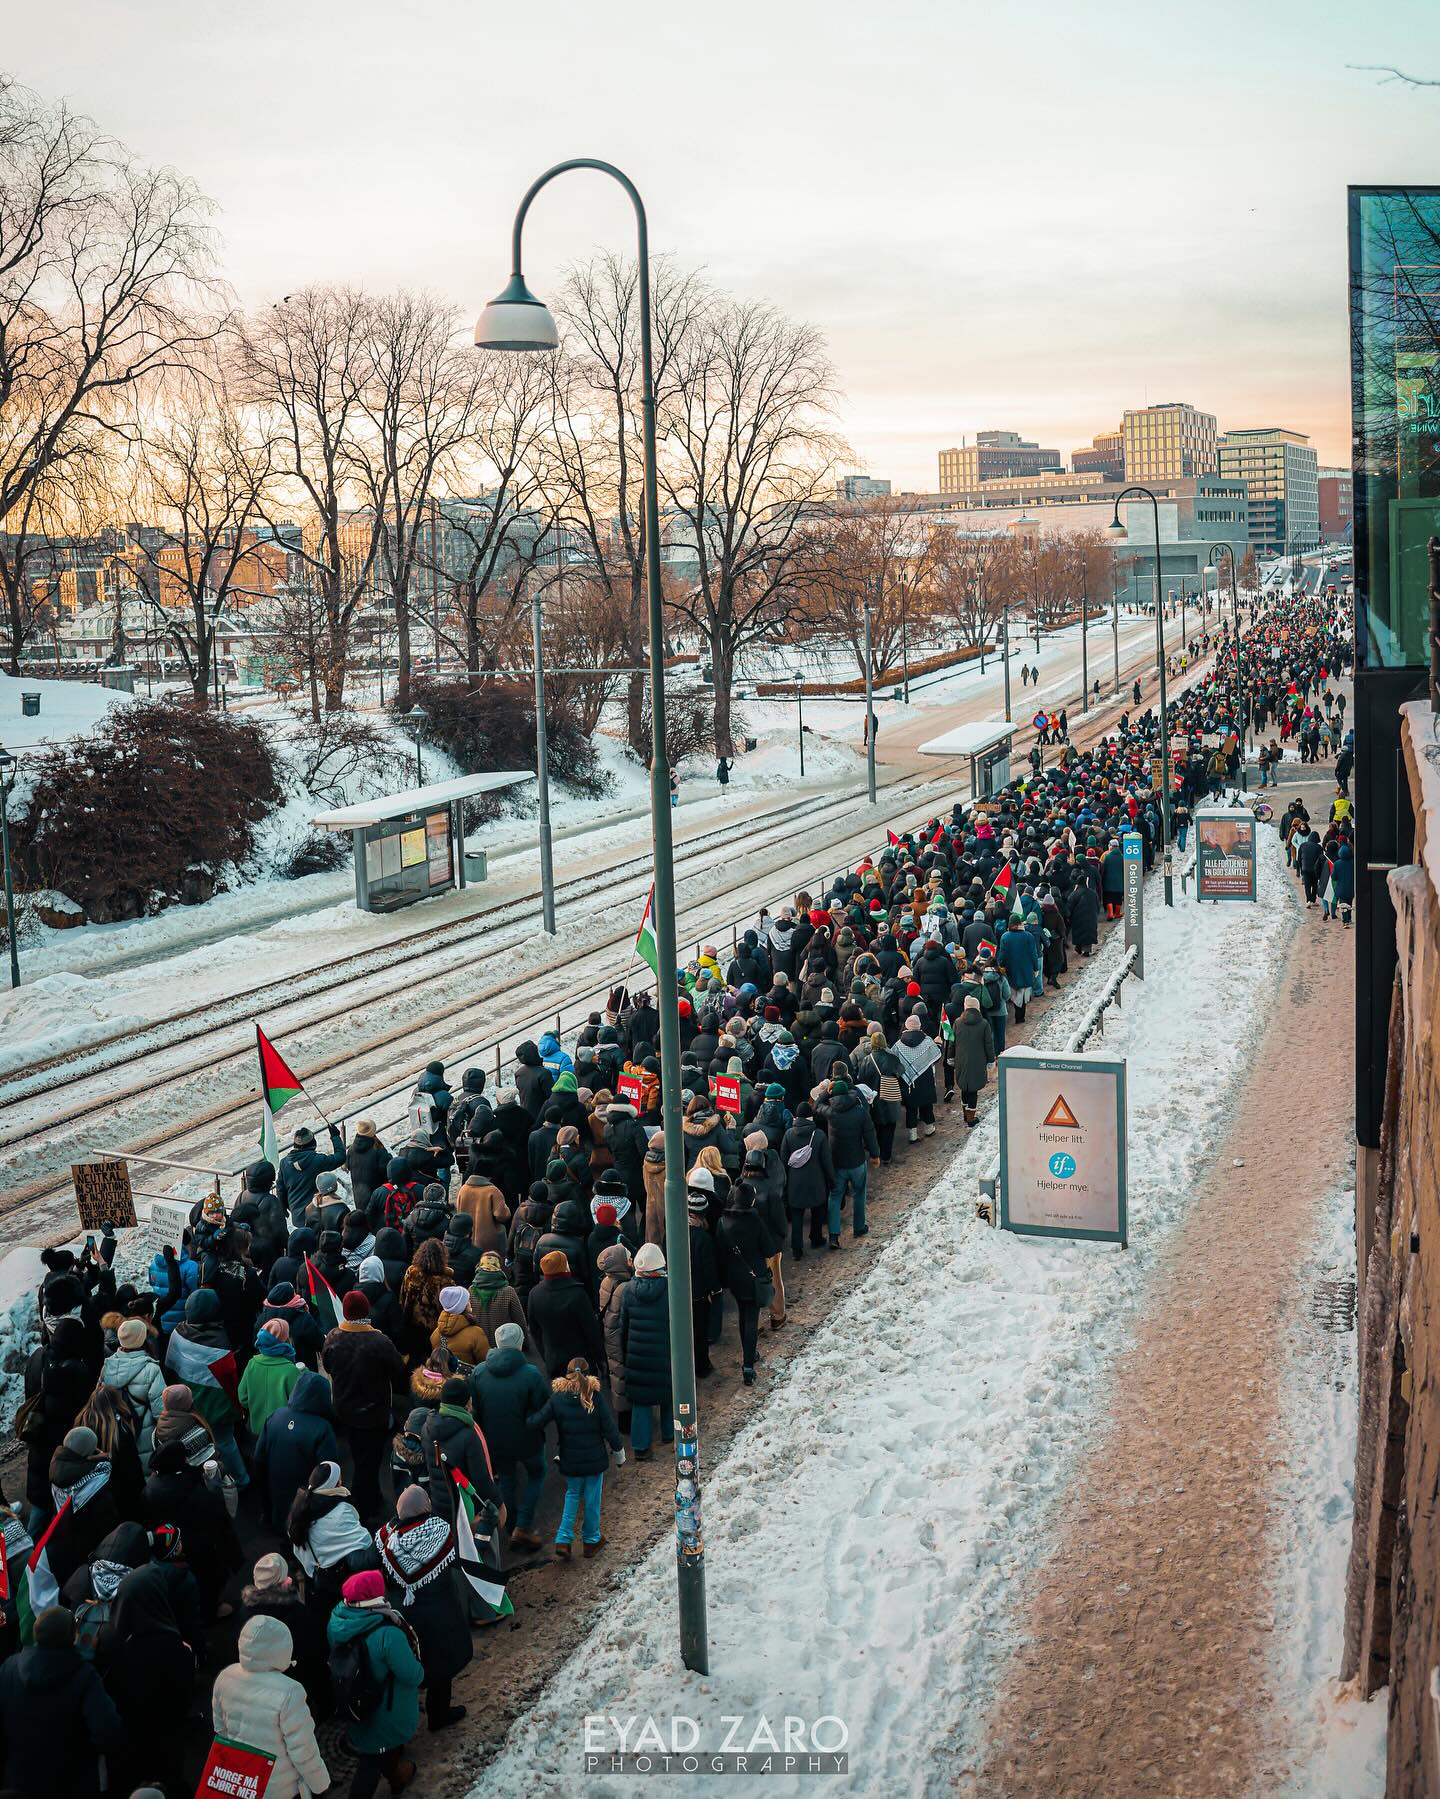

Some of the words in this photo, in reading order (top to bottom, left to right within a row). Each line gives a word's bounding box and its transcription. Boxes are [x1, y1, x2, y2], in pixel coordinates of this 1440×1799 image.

[1205, 859, 1218, 868] ALLE
[1129, 864, 1138, 885] Oslo
[1213, 868, 1224, 876] GOD
[1224, 868, 1248, 876] SAMTALE
[1128, 887, 1138, 927] Bysykkel
[1039, 1132, 1070, 1143] Hjelper
[1071, 1135, 1085, 1144] litt.
[78, 1165, 85, 1174] IF
[90, 1163, 105, 1173] YOU
[106, 1161, 121, 1171] ARE
[77, 1171, 125, 1184] NEUTRAL
[85, 1181, 129, 1193] SITUATIONS
[1037, 1180, 1067, 1191] Hjelper
[1069, 1184, 1089, 1193] mye.
[89, 1191, 130, 1202] INJUSTICE
[80, 1203, 92, 1211] YOU
[92, 1201, 110, 1211] HAVE
[110, 1200, 133, 1209] CHOSEN
[80, 1211, 93, 1219] THE
[213, 1766, 244, 1784] NORGE
[244, 1775, 259, 1790] MÅ
[207, 1776, 238, 1796] GJØRE
[236, 1785, 258, 1799] MER
